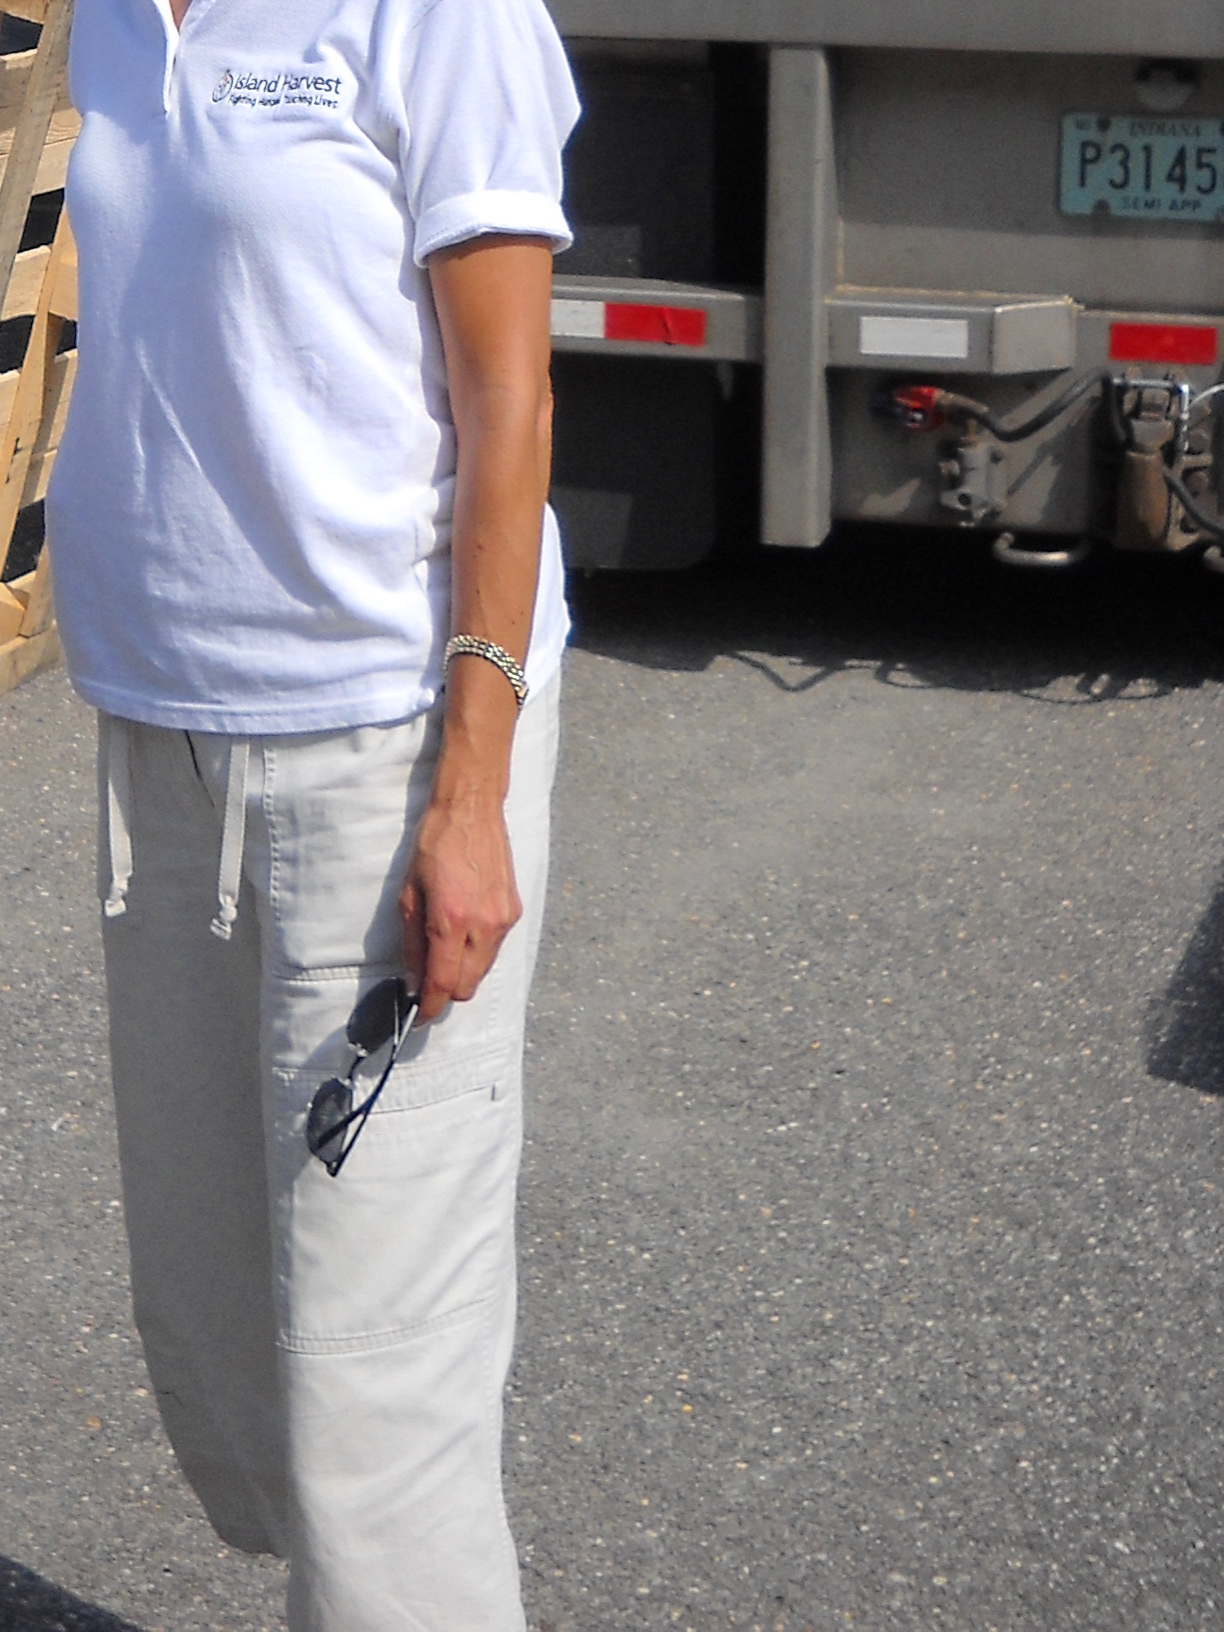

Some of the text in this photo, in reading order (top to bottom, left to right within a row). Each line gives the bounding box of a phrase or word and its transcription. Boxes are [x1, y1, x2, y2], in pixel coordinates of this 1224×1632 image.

[234, 72, 342, 95] Island Harvest
[1079, 141, 1217, 195] P3145
